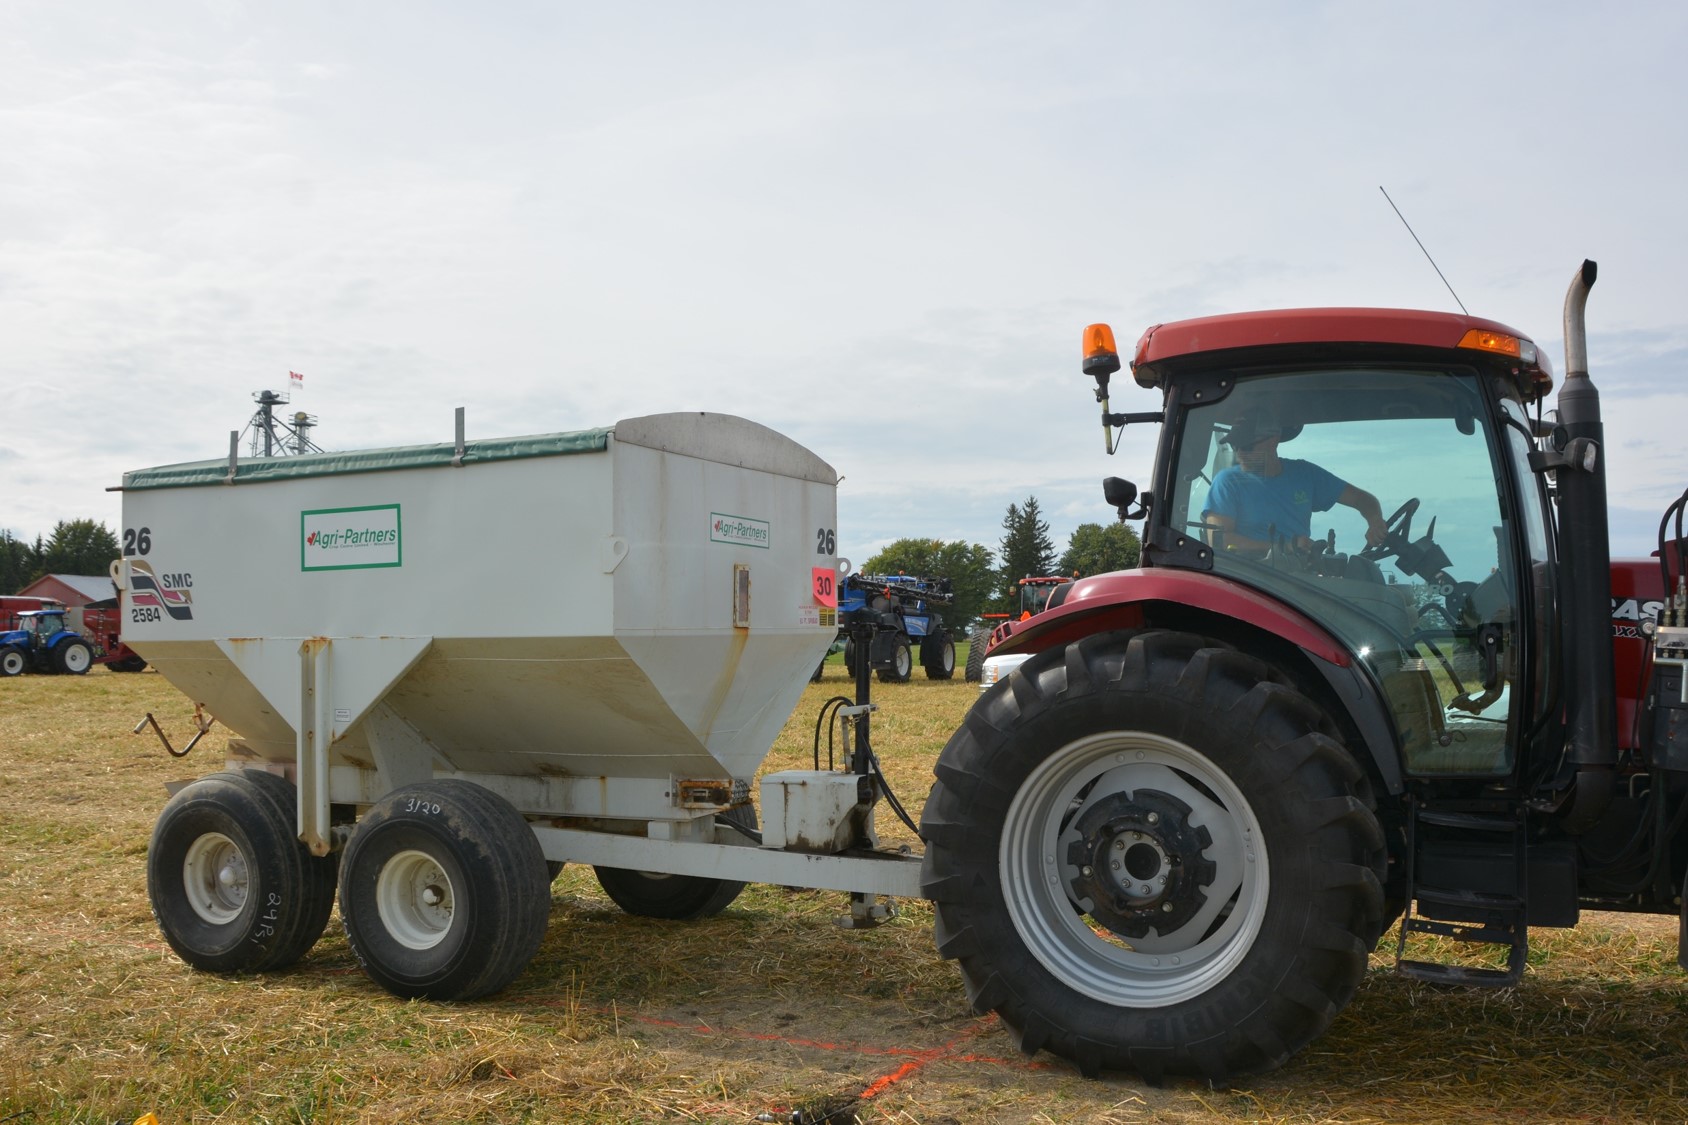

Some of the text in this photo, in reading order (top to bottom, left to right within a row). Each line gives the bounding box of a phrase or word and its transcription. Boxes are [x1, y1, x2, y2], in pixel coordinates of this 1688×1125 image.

[313, 528, 396, 549] Agri-Partners
[718, 520, 767, 540] Agri-Partners
[123, 527, 151, 556] 26
[817, 528, 835, 555] 26
[163, 573, 193, 589] SMC
[817, 576, 832, 596] 30
[132, 607, 161, 623] 2584
[1611, 598, 1665, 621] AS
